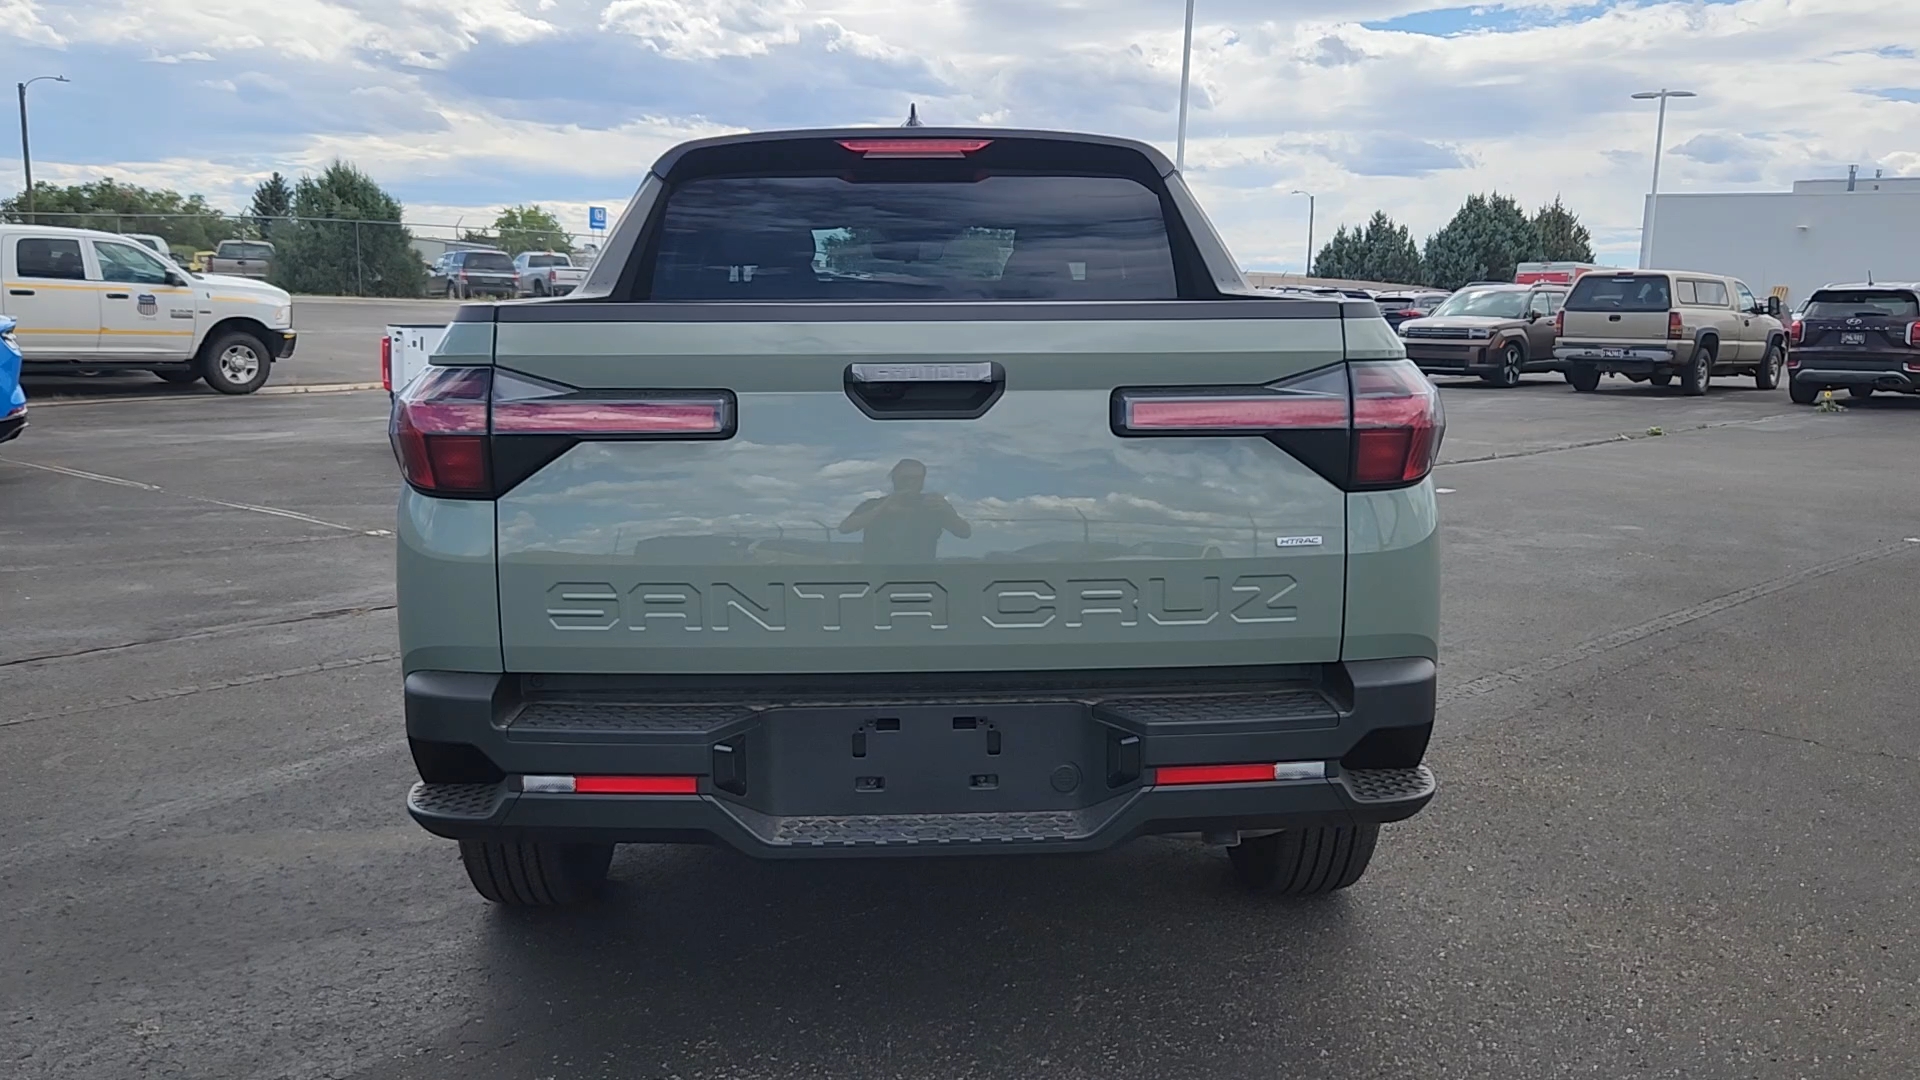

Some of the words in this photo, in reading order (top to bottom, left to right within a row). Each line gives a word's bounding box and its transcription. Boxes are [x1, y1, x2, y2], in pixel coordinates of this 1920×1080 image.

[1280, 537, 1319, 545] HTRAC
[546, 581, 948, 631] SANTA
[982, 574, 1298, 628] CRUZ
